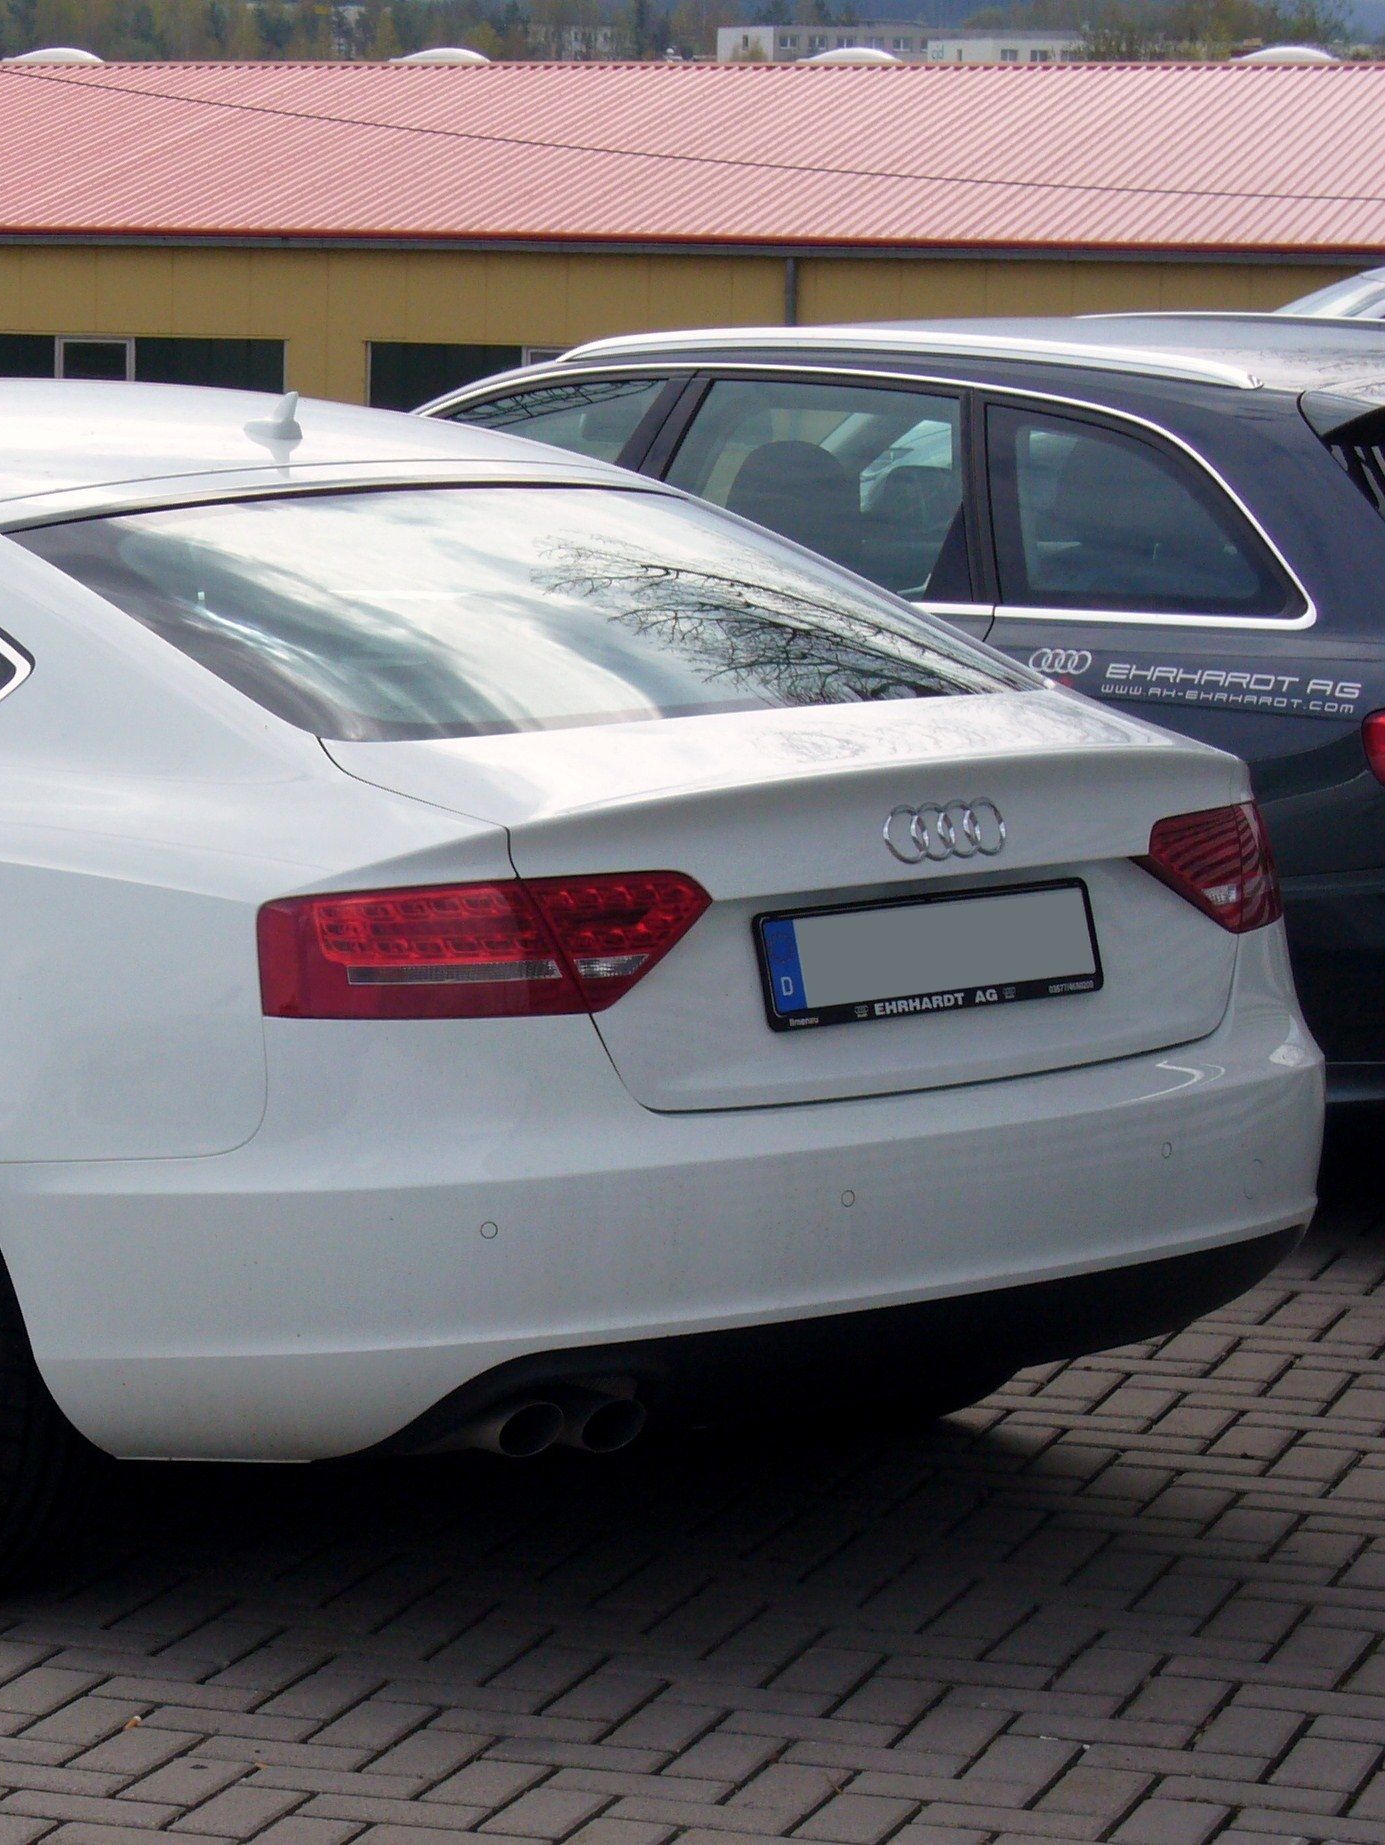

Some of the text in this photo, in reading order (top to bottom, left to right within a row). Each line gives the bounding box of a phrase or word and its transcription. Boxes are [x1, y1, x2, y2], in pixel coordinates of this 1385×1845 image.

[1105, 663, 1362, 699] EHRHARDT AG
[780, 976, 794, 996] D
[874, 988, 998, 1016] EHRHARDT AG
